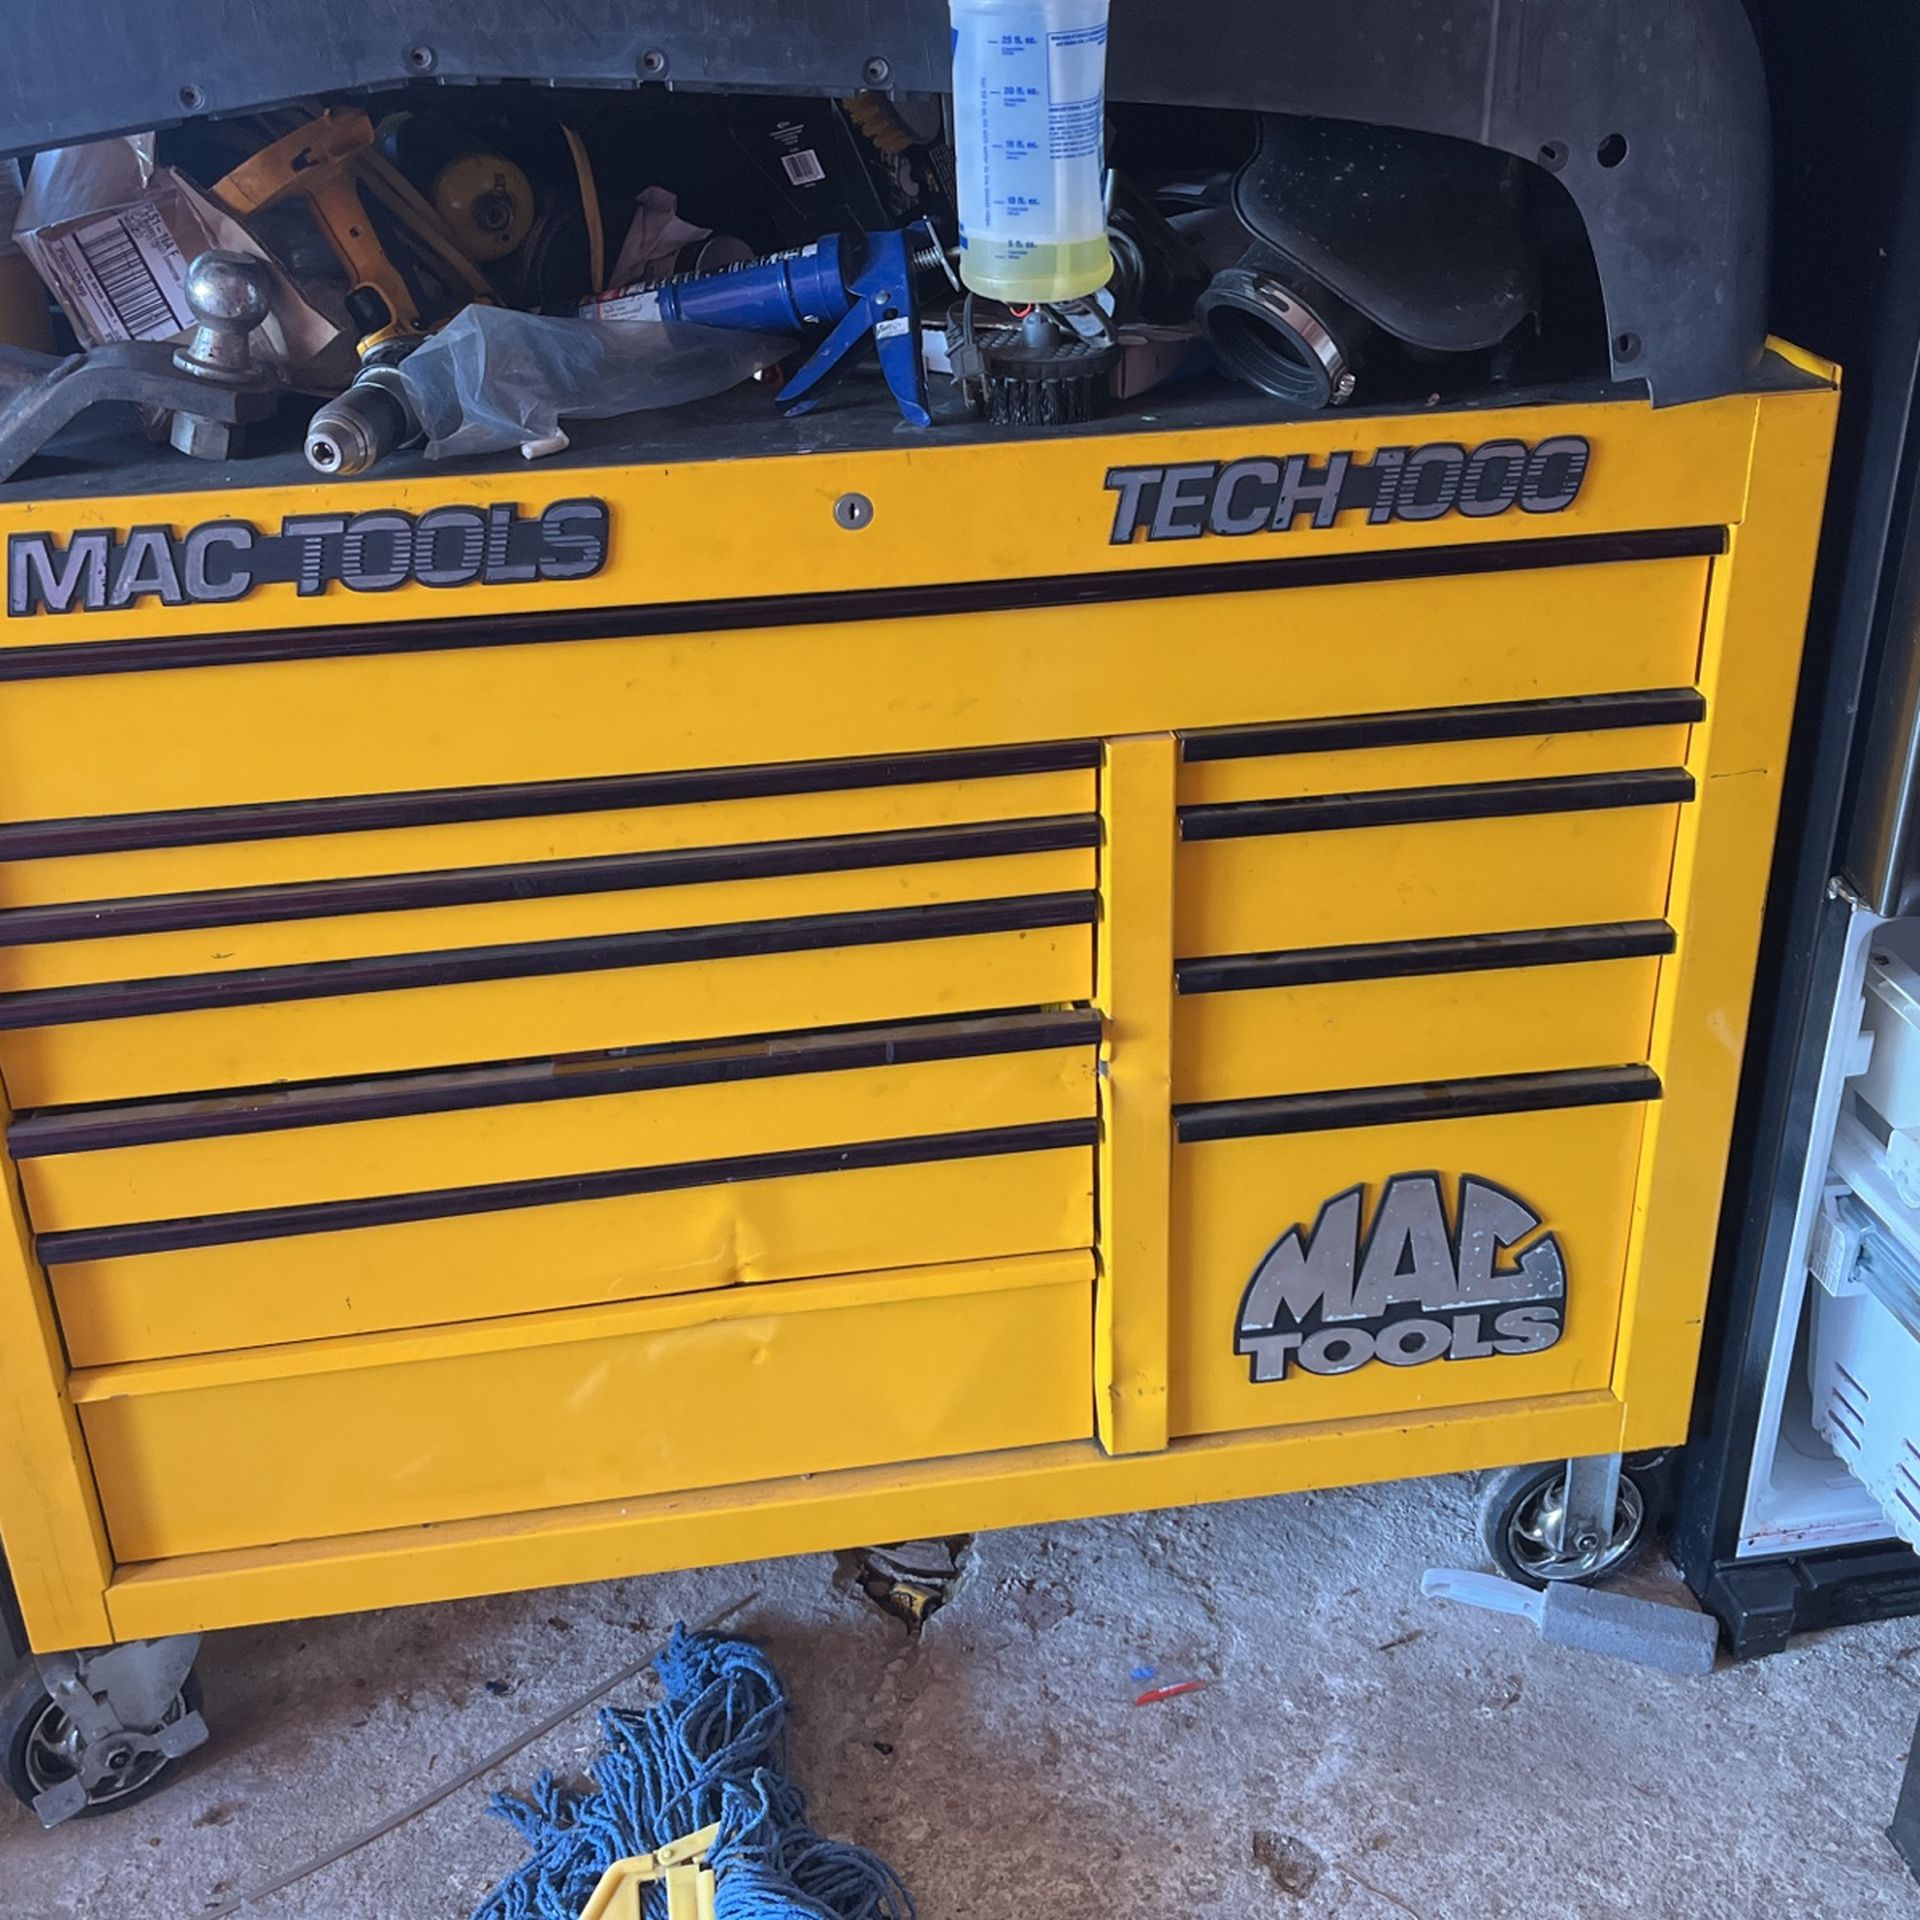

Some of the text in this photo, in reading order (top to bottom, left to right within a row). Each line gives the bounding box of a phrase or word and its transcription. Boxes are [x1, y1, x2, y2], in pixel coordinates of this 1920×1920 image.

[1001, 35, 1012, 44] 25
[1004, 86, 1014, 95] 20
[1007, 196, 1016, 205] 10
[1104, 436, 1590, 545] TECH 1000
[8, 498, 609, 617] MAC TOOLS
[1236, 1170, 1567, 1330] MAC
[1237, 1306, 1562, 1382] TOOLS
